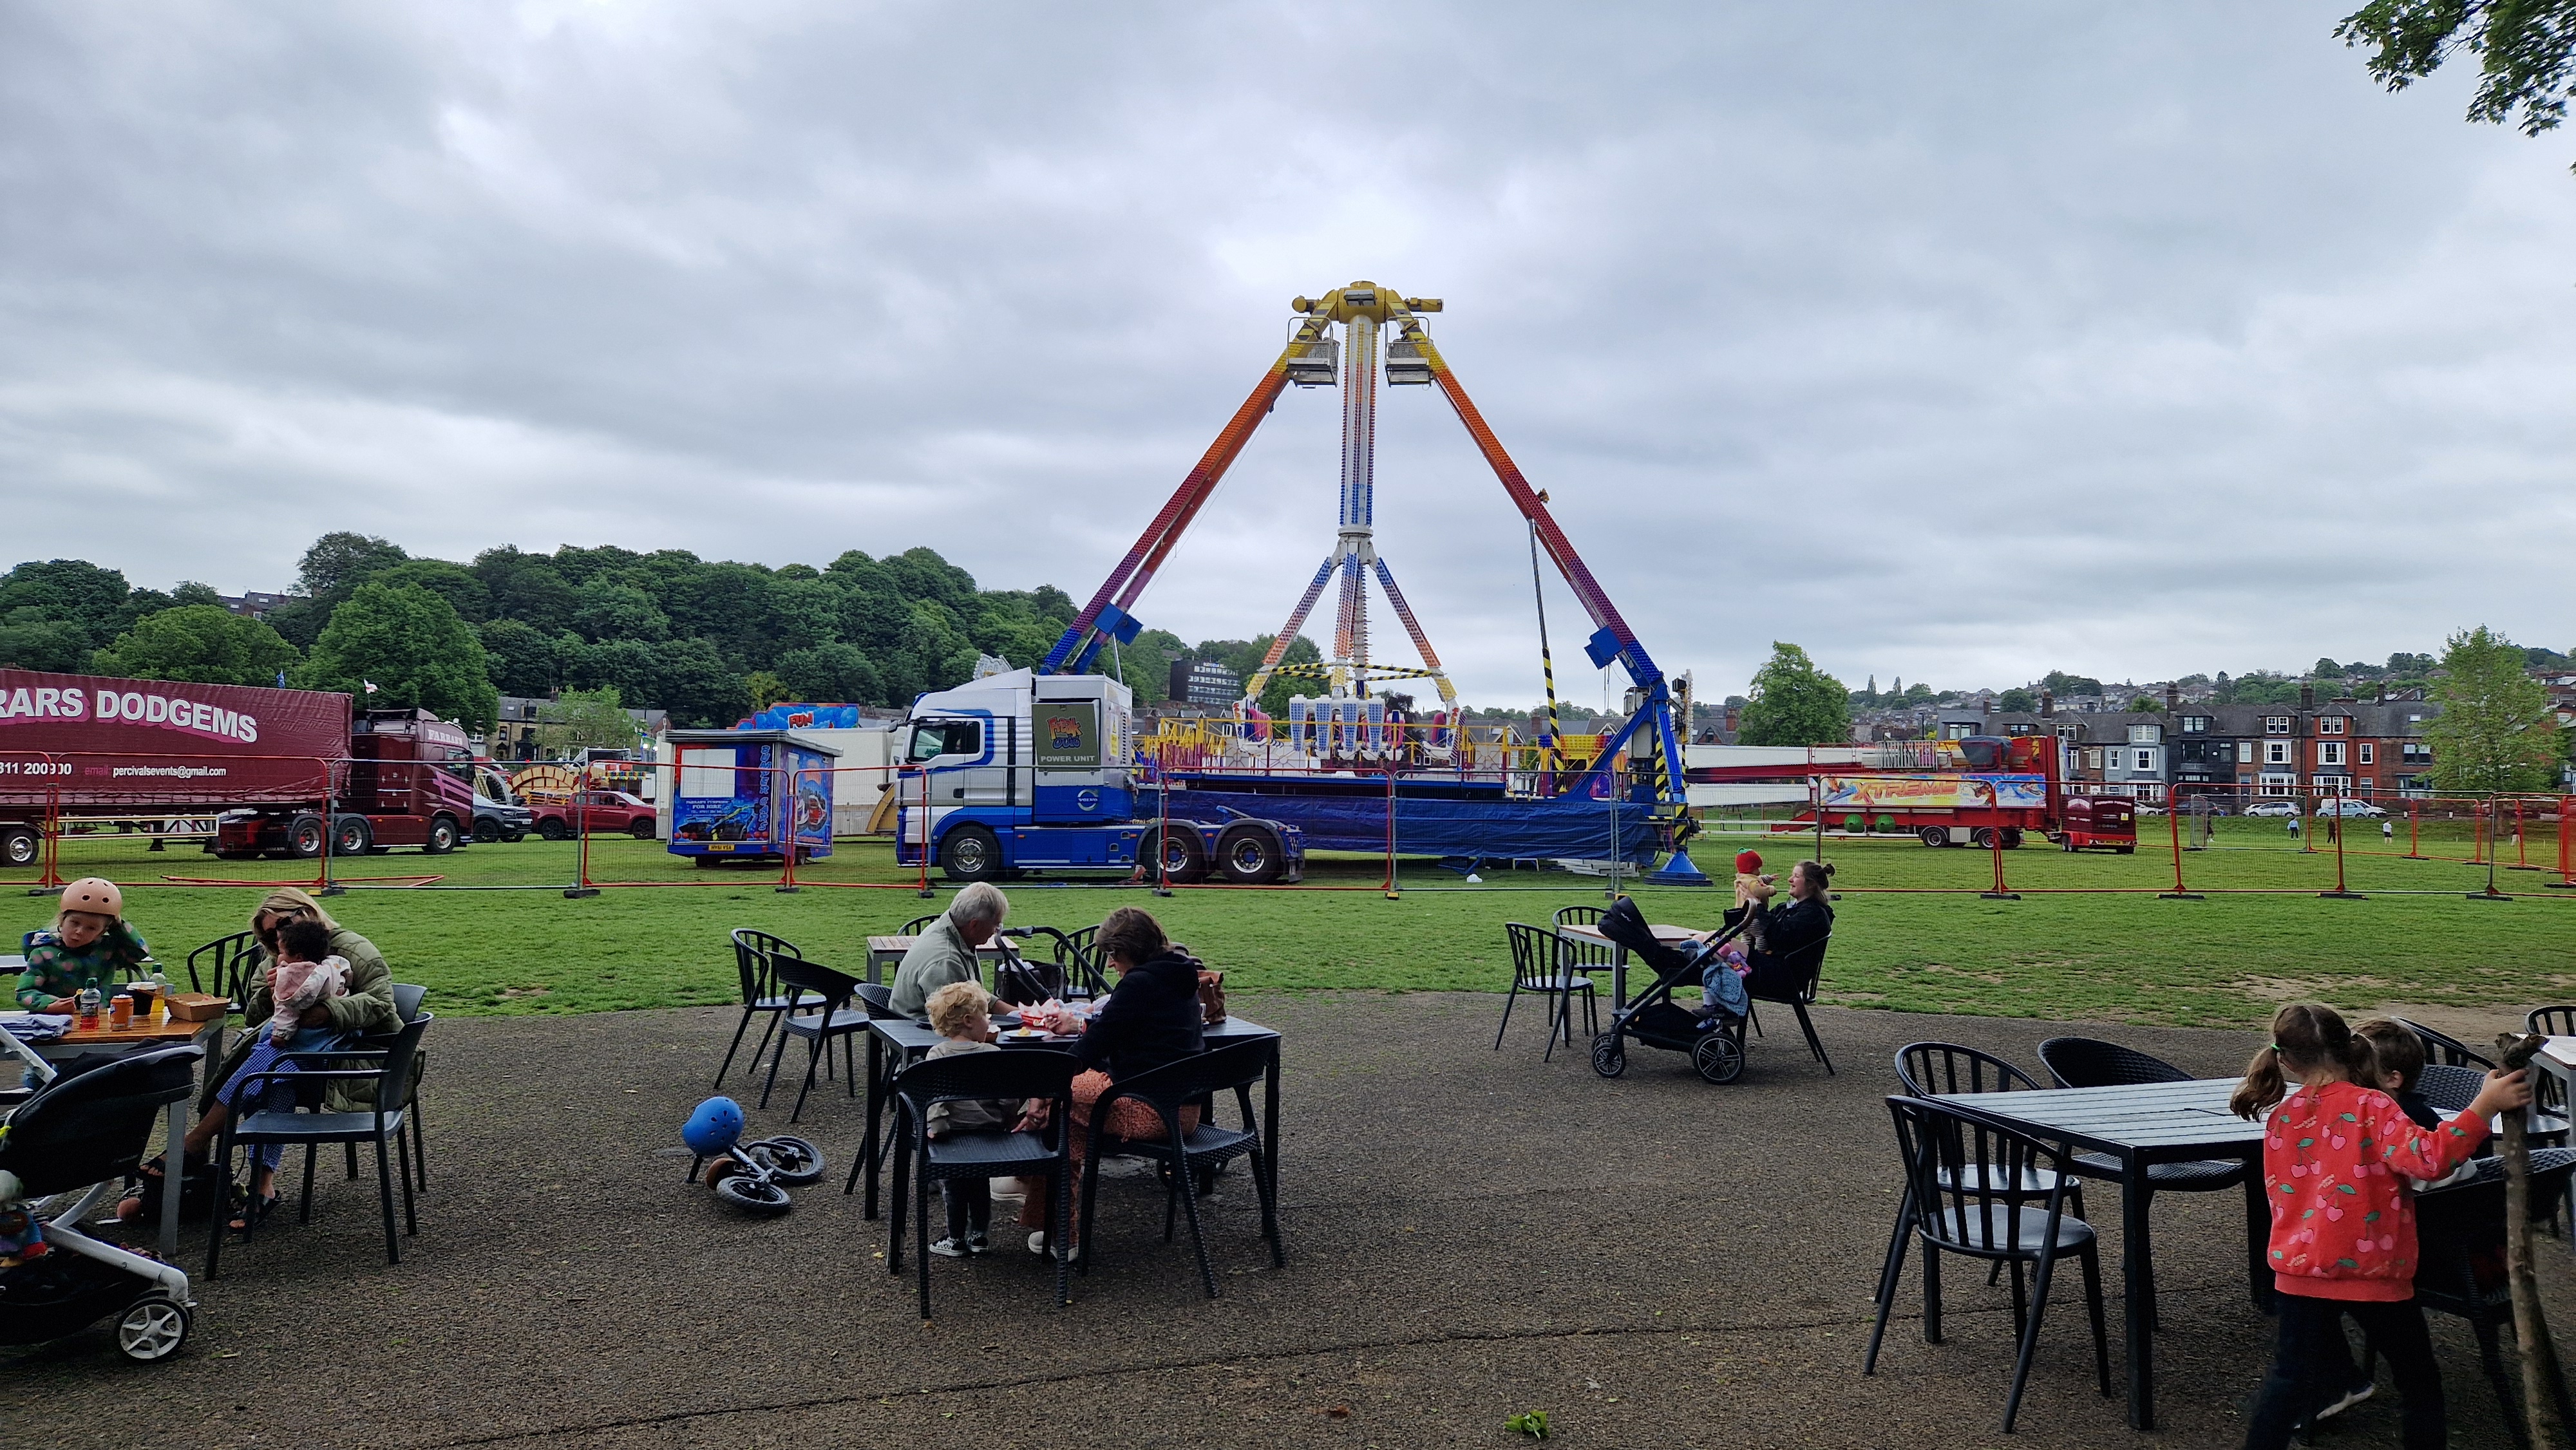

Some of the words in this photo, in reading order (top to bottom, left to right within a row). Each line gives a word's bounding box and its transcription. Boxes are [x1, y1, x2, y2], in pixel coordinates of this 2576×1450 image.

[97, 690, 258, 744] DODGEMS
[788, 711, 814, 728] FUN
[112, 765, 227, 778] percivalsevents@gmail.com
[758, 745, 772, 795] BUMPER
[1852, 775, 1960, 805] XTREME
[757, 796, 770, 831] CARS
